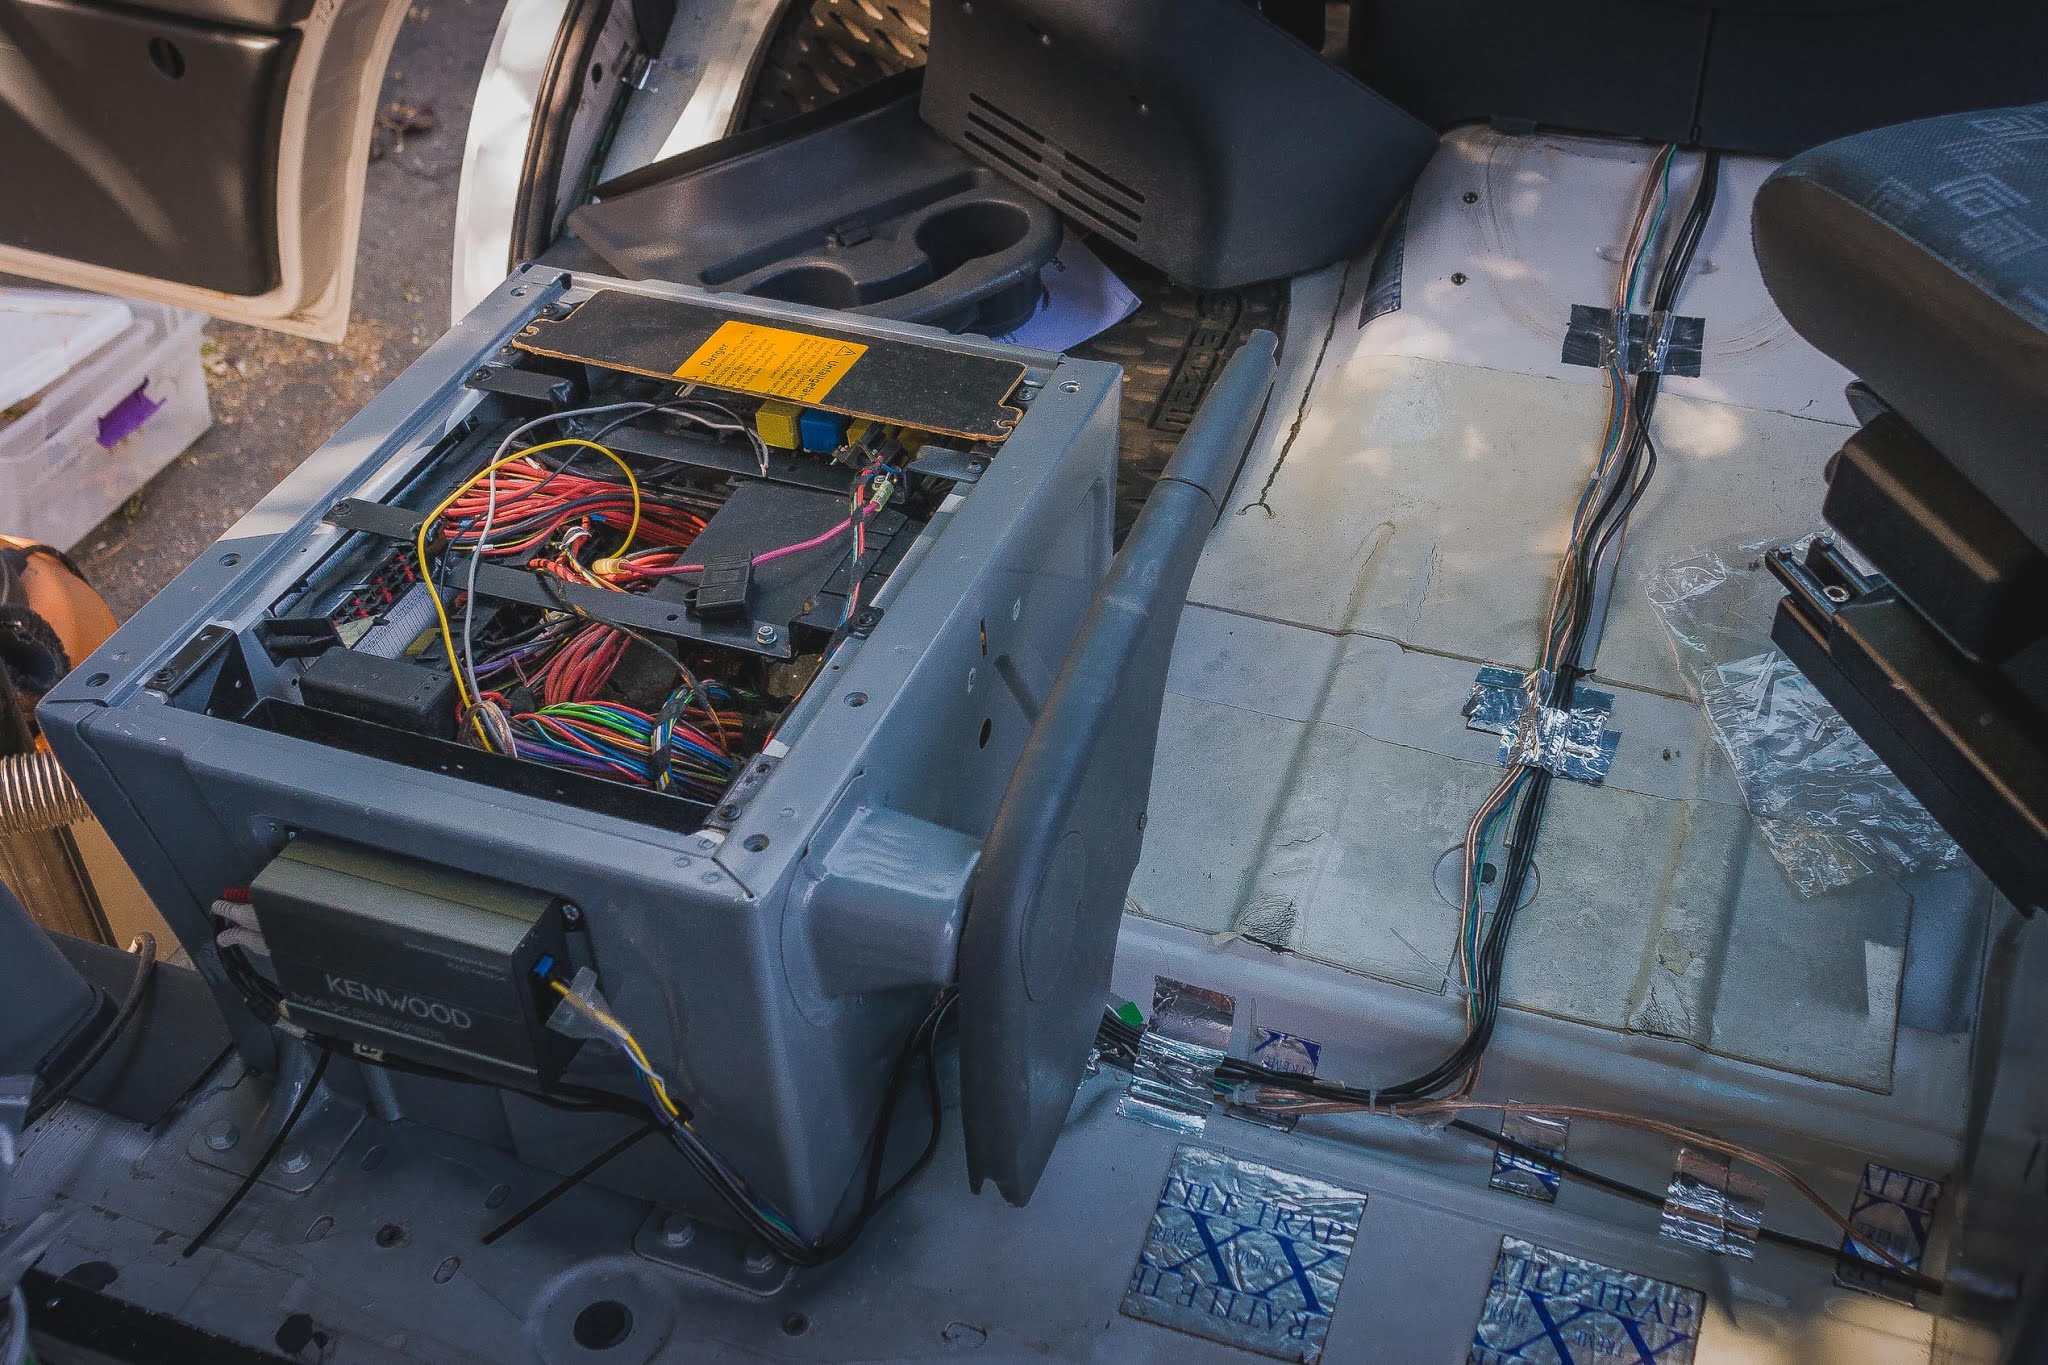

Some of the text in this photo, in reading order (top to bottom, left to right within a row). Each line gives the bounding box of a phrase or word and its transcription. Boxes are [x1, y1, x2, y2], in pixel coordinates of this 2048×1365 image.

[700, 343, 730, 367] Danger
[707, 352, 734, 375] performing
[737, 334, 751, 344] work
[733, 362, 746, 370] first
[748, 338, 770, 355] negative
[733, 374, 745, 382] and
[741, 365, 754, 374] then
[757, 342, 776, 357] positive
[791, 338, 810, 353] Batterie
[742, 374, 756, 384] from
[770, 380, 781, 388] von
[791, 368, 804, 377] und
[797, 360, 839, 401] Unfallgefahr
[324, 973, 473, 1030] KENWOOD
[1257, 1201, 1347, 1245] TRAP
[1592, 1279, 1695, 1329] TRAP
